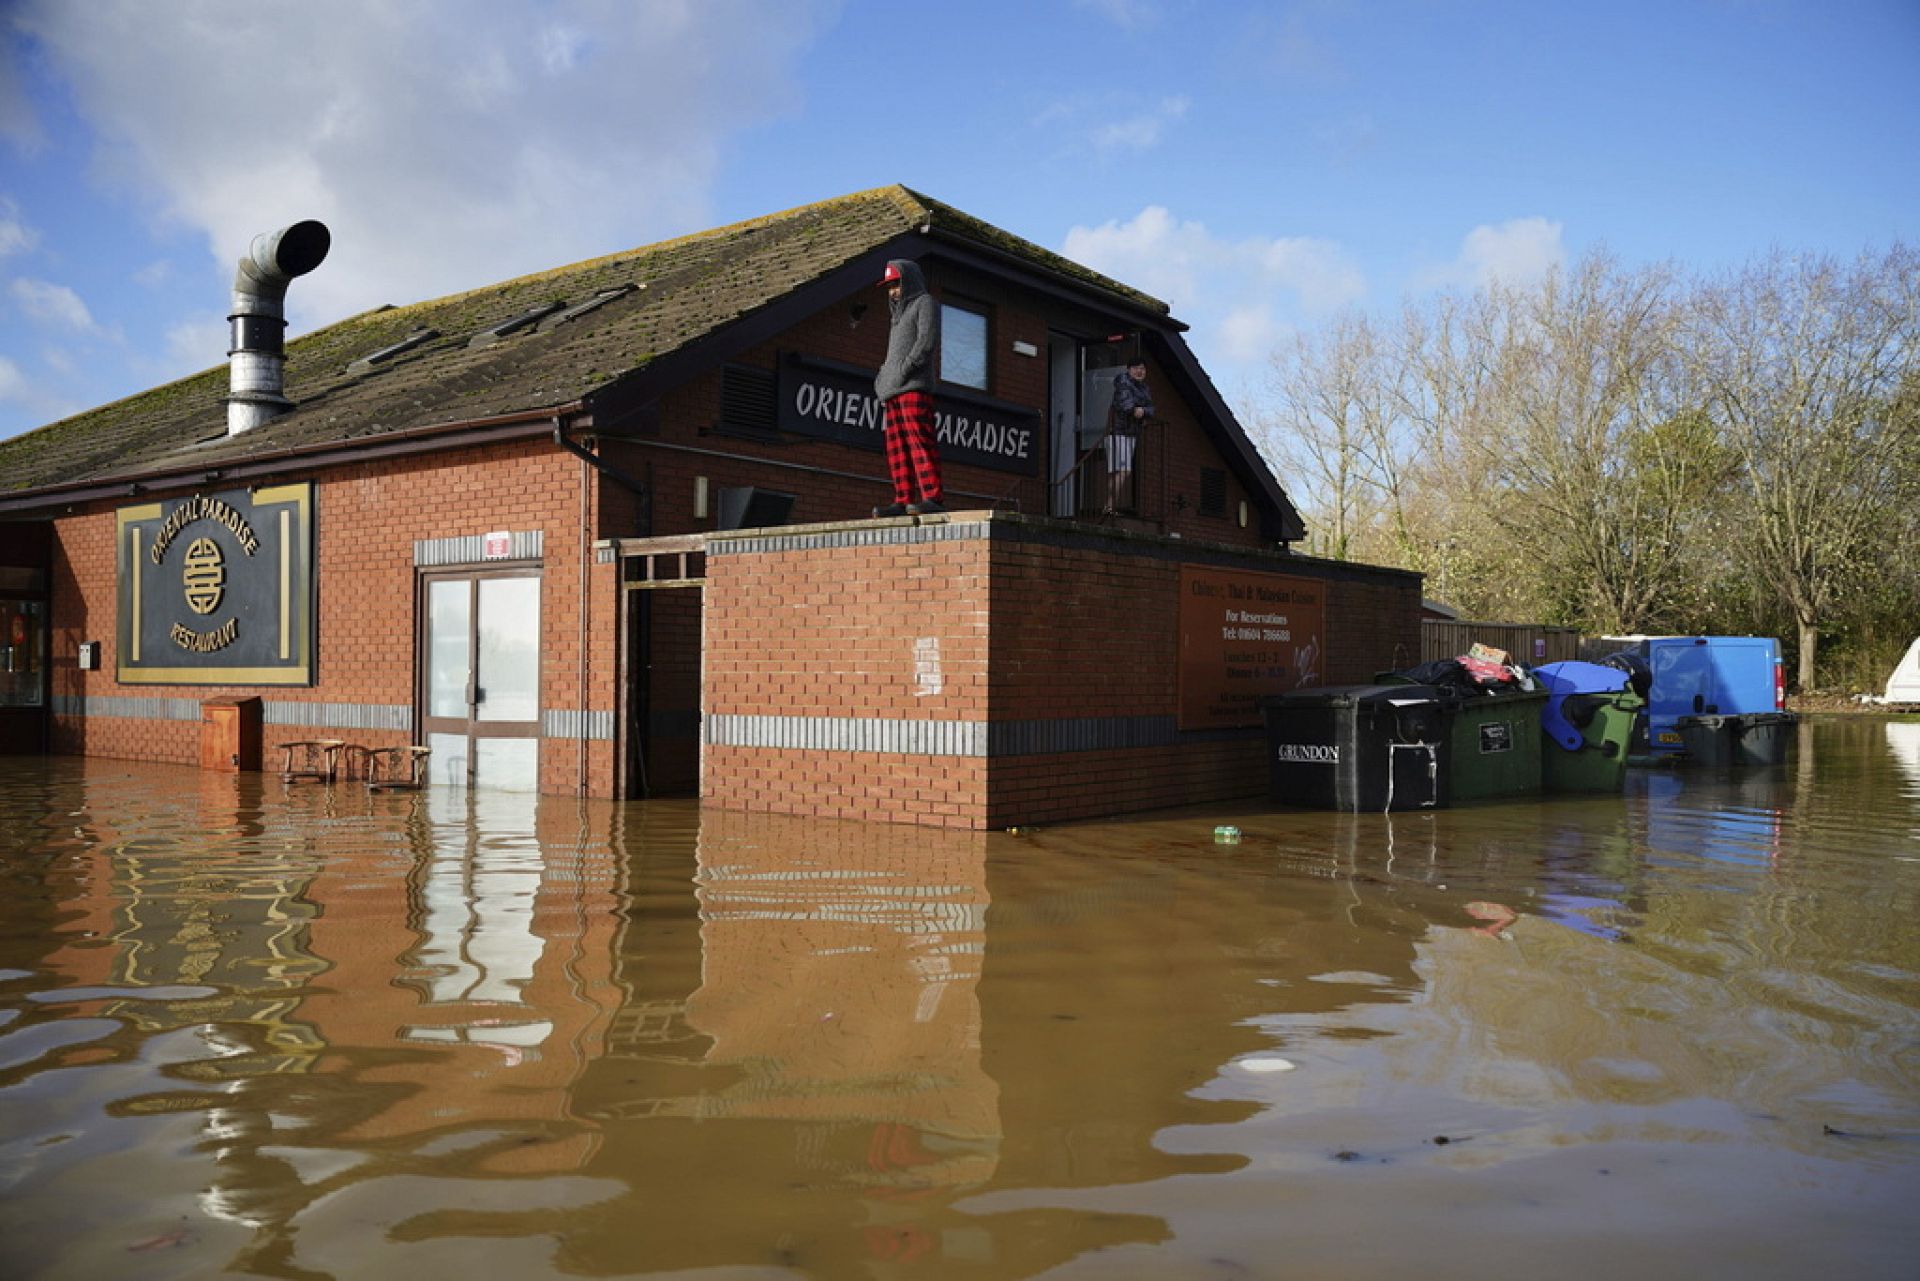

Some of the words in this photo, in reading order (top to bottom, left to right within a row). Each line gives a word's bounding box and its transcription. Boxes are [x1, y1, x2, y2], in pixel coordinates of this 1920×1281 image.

[152, 498, 199, 565] ORIENTAL
[200, 498, 258, 556] PARADISE
[1225, 608, 1239, 622] For
[1240, 610, 1288, 625] Reservations
[170, 617, 236, 652] RESTAURANT
[1278, 744, 1340, 760] GRUNDON
